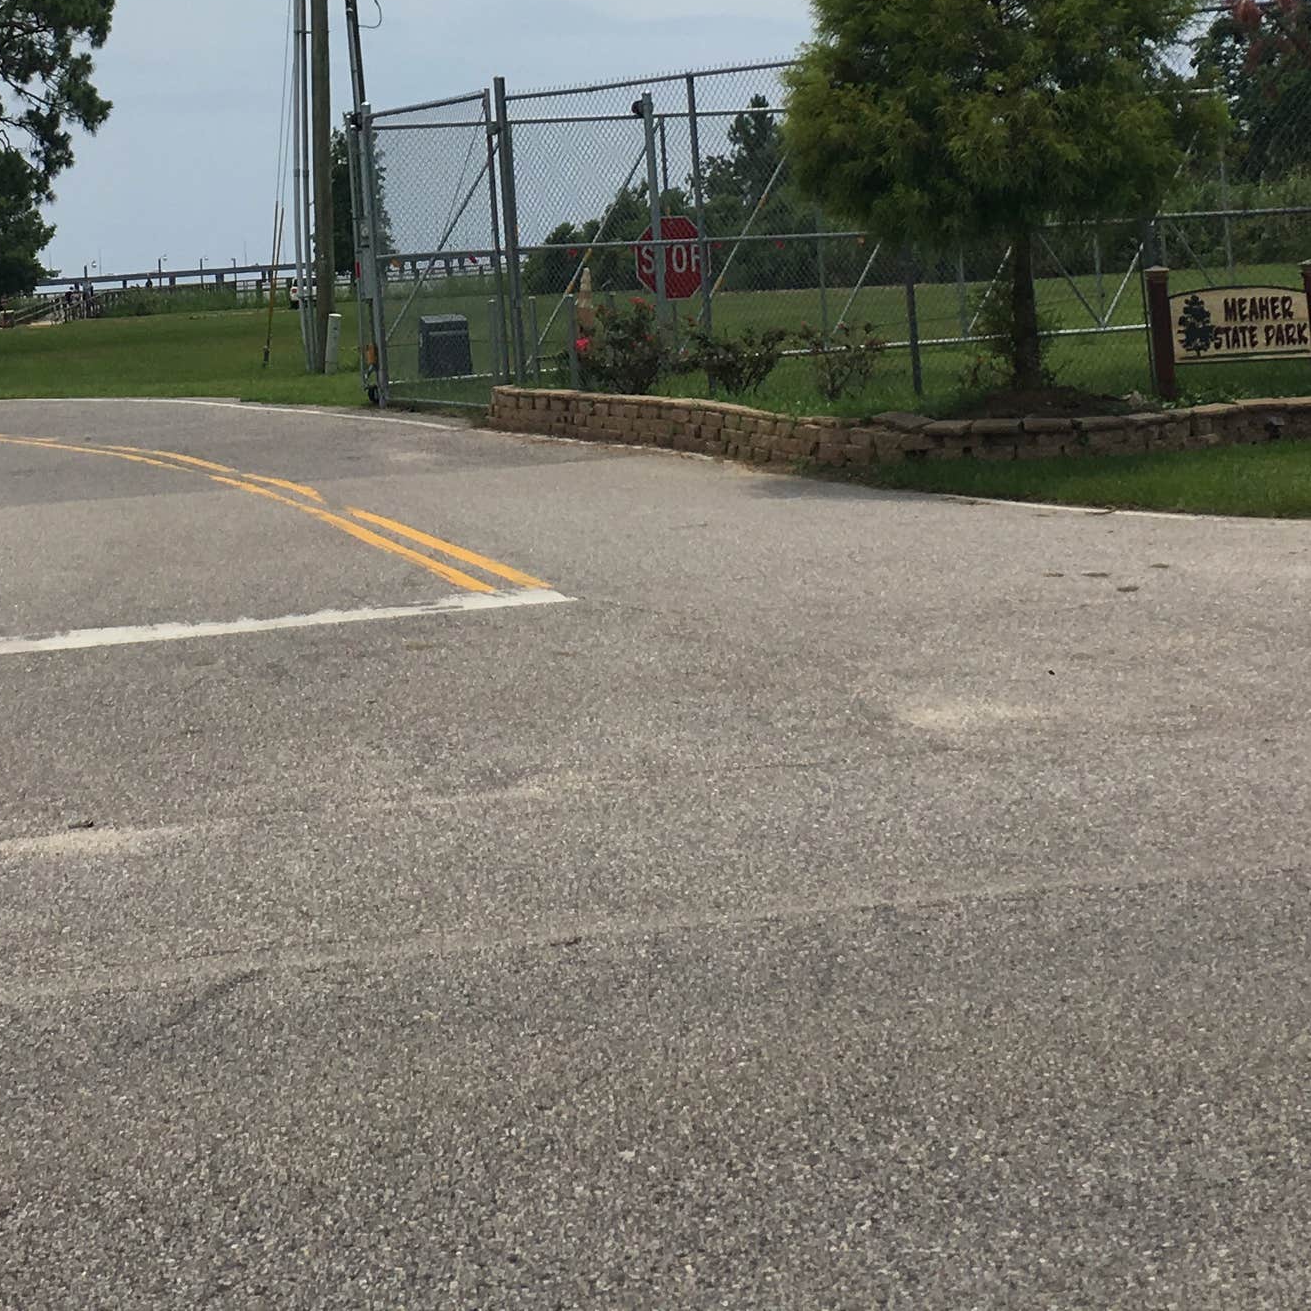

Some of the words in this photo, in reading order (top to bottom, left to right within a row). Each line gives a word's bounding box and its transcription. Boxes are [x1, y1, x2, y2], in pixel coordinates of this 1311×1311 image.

[641, 243, 702, 274] SOP
[1224, 295, 1293, 322] MEAHER
[1213, 325, 1259, 350] STATE
[1264, 322, 1308, 347] PARK
